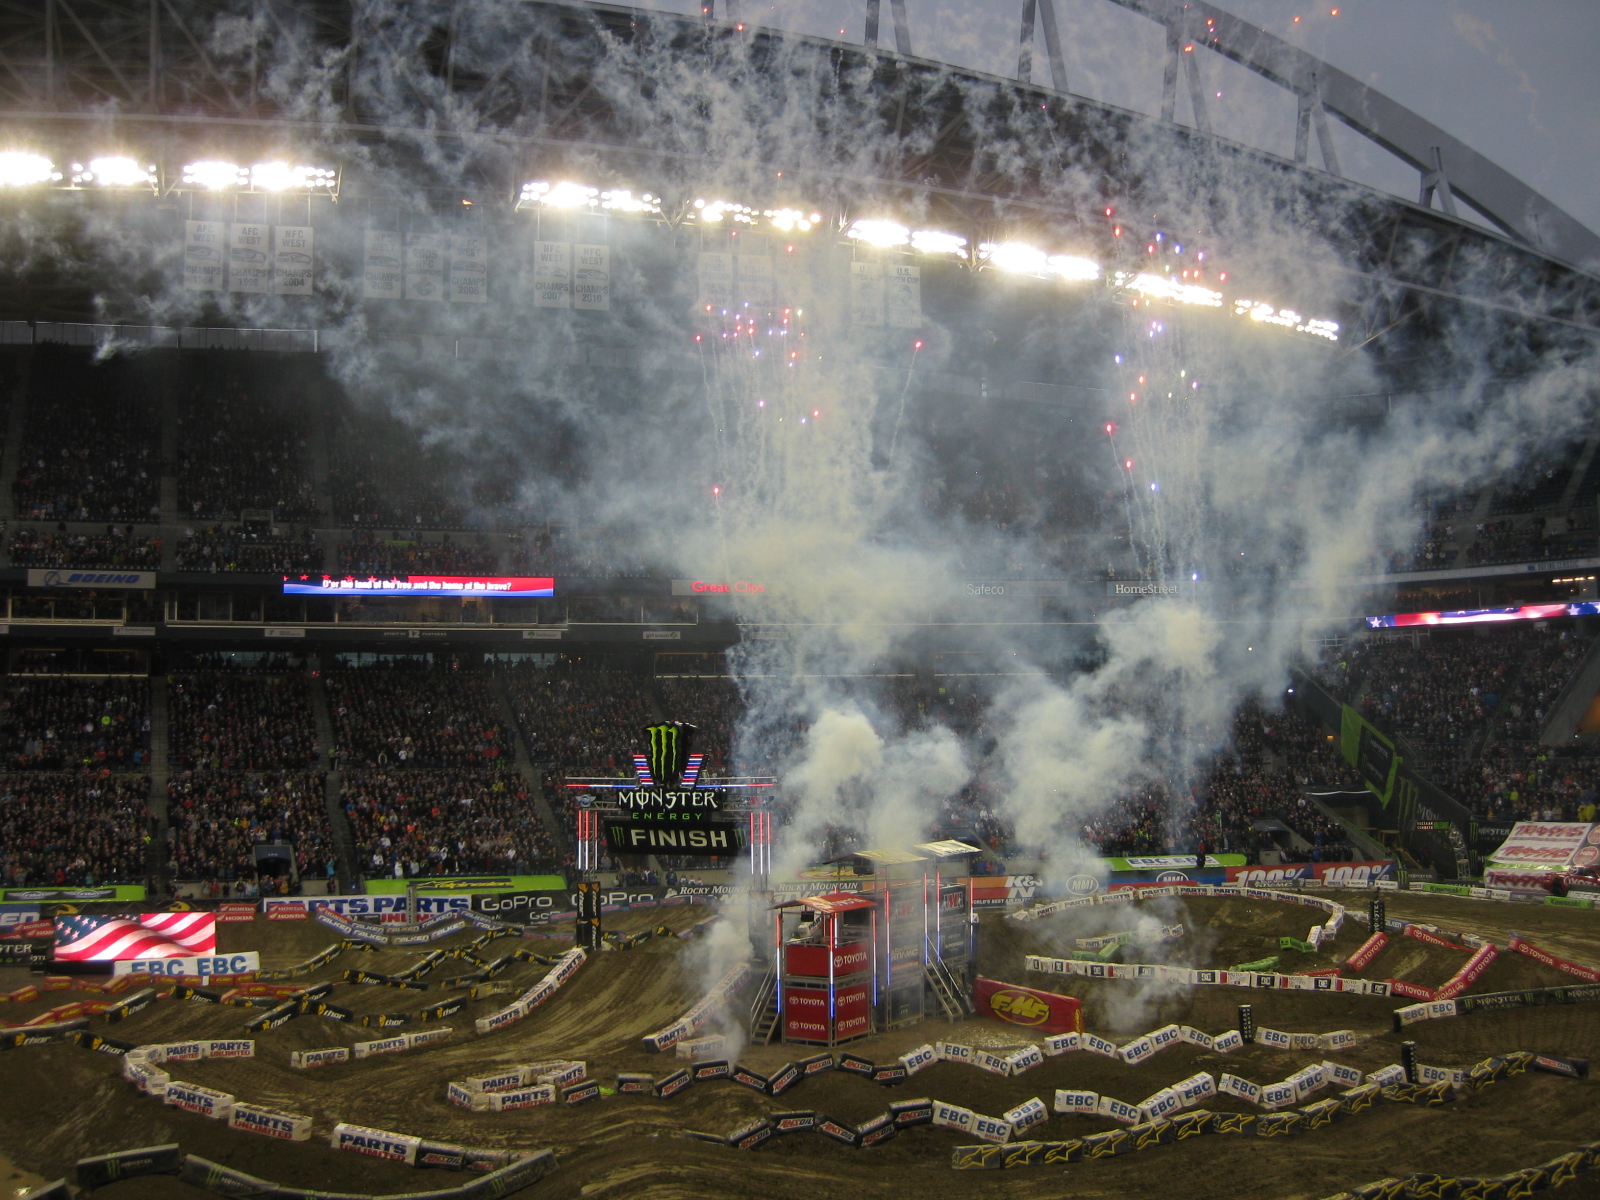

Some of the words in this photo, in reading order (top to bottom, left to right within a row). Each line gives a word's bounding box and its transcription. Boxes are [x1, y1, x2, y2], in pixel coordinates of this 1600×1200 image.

[238, 237, 262, 245] WEST
[285, 230, 304, 239] NFC
[282, 239, 306, 248] WEST
[543, 245, 561, 253] NFC
[540, 254, 564, 262] WEST
[584, 248, 601, 257] NFC
[581, 257, 604, 265] WEST
[231, 269, 267, 278] CHAMPS
[275, 269, 312, 278] CHAMPS
[365, 272, 401, 282] CHAMPS
[897, 267, 913, 277] U.S.
[283, 278, 305, 287] 2004
[372, 282, 393, 291] 2005
[452, 277, 487, 287] CHAMPS
[907, 276, 920, 284] CUP
[535, 282, 569, 292] CHAMPS
[575, 285, 609, 294] CHAMPS
[68, 573, 140, 584] BOEING
[341, 580, 353, 588] the
[354, 580, 373, 589] land
[373, 580, 382, 589] of
[383, 580, 396, 589] the
[397, 581, 412, 589] free
[414, 581, 428, 589] and
[429, 581, 442, 590] the
[443, 581, 464, 590] home
[465, 582, 474, 590] of
[474, 582, 487, 590] the
[487, 582, 512, 591] brave?
[691, 580, 730, 593] Great
[734, 581, 765, 593] Clips
[966, 583, 1004, 595] Safeco
[1115, 583, 1179, 595] HomeStreet
[408, 629, 421, 638] 12
[618, 788, 718, 809] MONSTER
[632, 812, 703, 820] ENERGY
[630, 829, 728, 847] FINISH
[679, 886, 710, 895] ROCKY
[809, 882, 859, 890] MOUNTAIN
[1072, 880, 1093, 889] MMI
[481, 896, 553, 911] GoPro
[318, 915, 352, 932] FALKEN
[421, 912, 452, 928] FALKEN
[352, 922, 384, 933] FALKEN
[432, 921, 465, 938] FALKEN
[353, 929, 388, 943] FALKEN
[1363, 939, 1385, 960] TOYOTA
[843, 953, 868, 965] TOYOTA
[1474, 951, 1496, 974] TOYOTA
[1528, 949, 1554, 966] TOYOTA
[131, 958, 184, 977] EBC
[197, 955, 247, 976] EBC
[1570, 966, 1596, 981] TOYOTA
[362, 976, 381, 985] thor
[846, 992, 866, 1004] TOYOTA
[1405, 985, 1430, 998] TOYOTA
[799, 997, 825, 1006] TOYOTA
[1477, 994, 1522, 1005] MONSTER
[129, 1001, 149, 1016] thor
[442, 1005, 460, 1017] thor
[991, 994, 1049, 1019] FMF
[323, 1009, 346, 1019] thor
[489, 1008, 521, 1027] PARTS
[270, 1013, 291, 1029] thor
[385, 1018, 405, 1027] thor
[800, 1022, 825, 1031] TOYOTA
[846, 1017, 866, 1028] TOYOTA
[23, 1035, 51, 1046] thor
[658, 1025, 687, 1044] PARTS
[1154, 1029, 1178, 1046] EBC
[1264, 1031, 1288, 1044] EBC
[99, 1043, 125, 1055] thor
[166, 1044, 199, 1055] PARTS
[210, 1041, 251, 1051] PARTS
[369, 1038, 405, 1051] PARTS
[1053, 1037, 1078, 1051] EBC
[210, 1050, 251, 1058] UNLIMITED
[1126, 1042, 1151, 1060] EBC
[698, 1066, 728, 1078] AMSOIL
[805, 1058, 833, 1073] AMSOIL
[841, 1059, 873, 1072] AMSOIL
[773, 1067, 797, 1093] AMSOIL
[874, 1069, 905, 1081] AMSOIL
[1334, 1067, 1358, 1081] EBC
[483, 1075, 520, 1089] PARTS
[662, 1075, 689, 1095] AMSOIL
[735, 1074, 765, 1088] AMSOIL
[1231, 1078, 1259, 1096] EBC
[1298, 1072, 1323, 1091] EBC
[167, 1088, 213, 1108] PARTS
[502, 1089, 550, 1104] PARTS
[567, 1087, 598, 1102] AMSOIL
[1065, 1094, 1094, 1107] EBC
[1110, 1102, 1138, 1119] EBC
[1150, 1096, 1176, 1117] EBC
[236, 1110, 294, 1132] PARTS
[899, 1109, 932, 1122] AMSOIL
[939, 1108, 970, 1125] EBC
[1016, 1110, 1044, 1130] EBC
[235, 1120, 293, 1139] UNLIMITED
[780, 1117, 814, 1129] AMSOIL
[947, 1121, 967, 1130] BRAKES
[977, 1120, 1007, 1136] EBC
[822, 1121, 855, 1141] AMSOIL
[862, 1124, 894, 1146] AMSOIL
[339, 1133, 407, 1155] PARTS
[984, 1134, 1004, 1142] BRAKES
